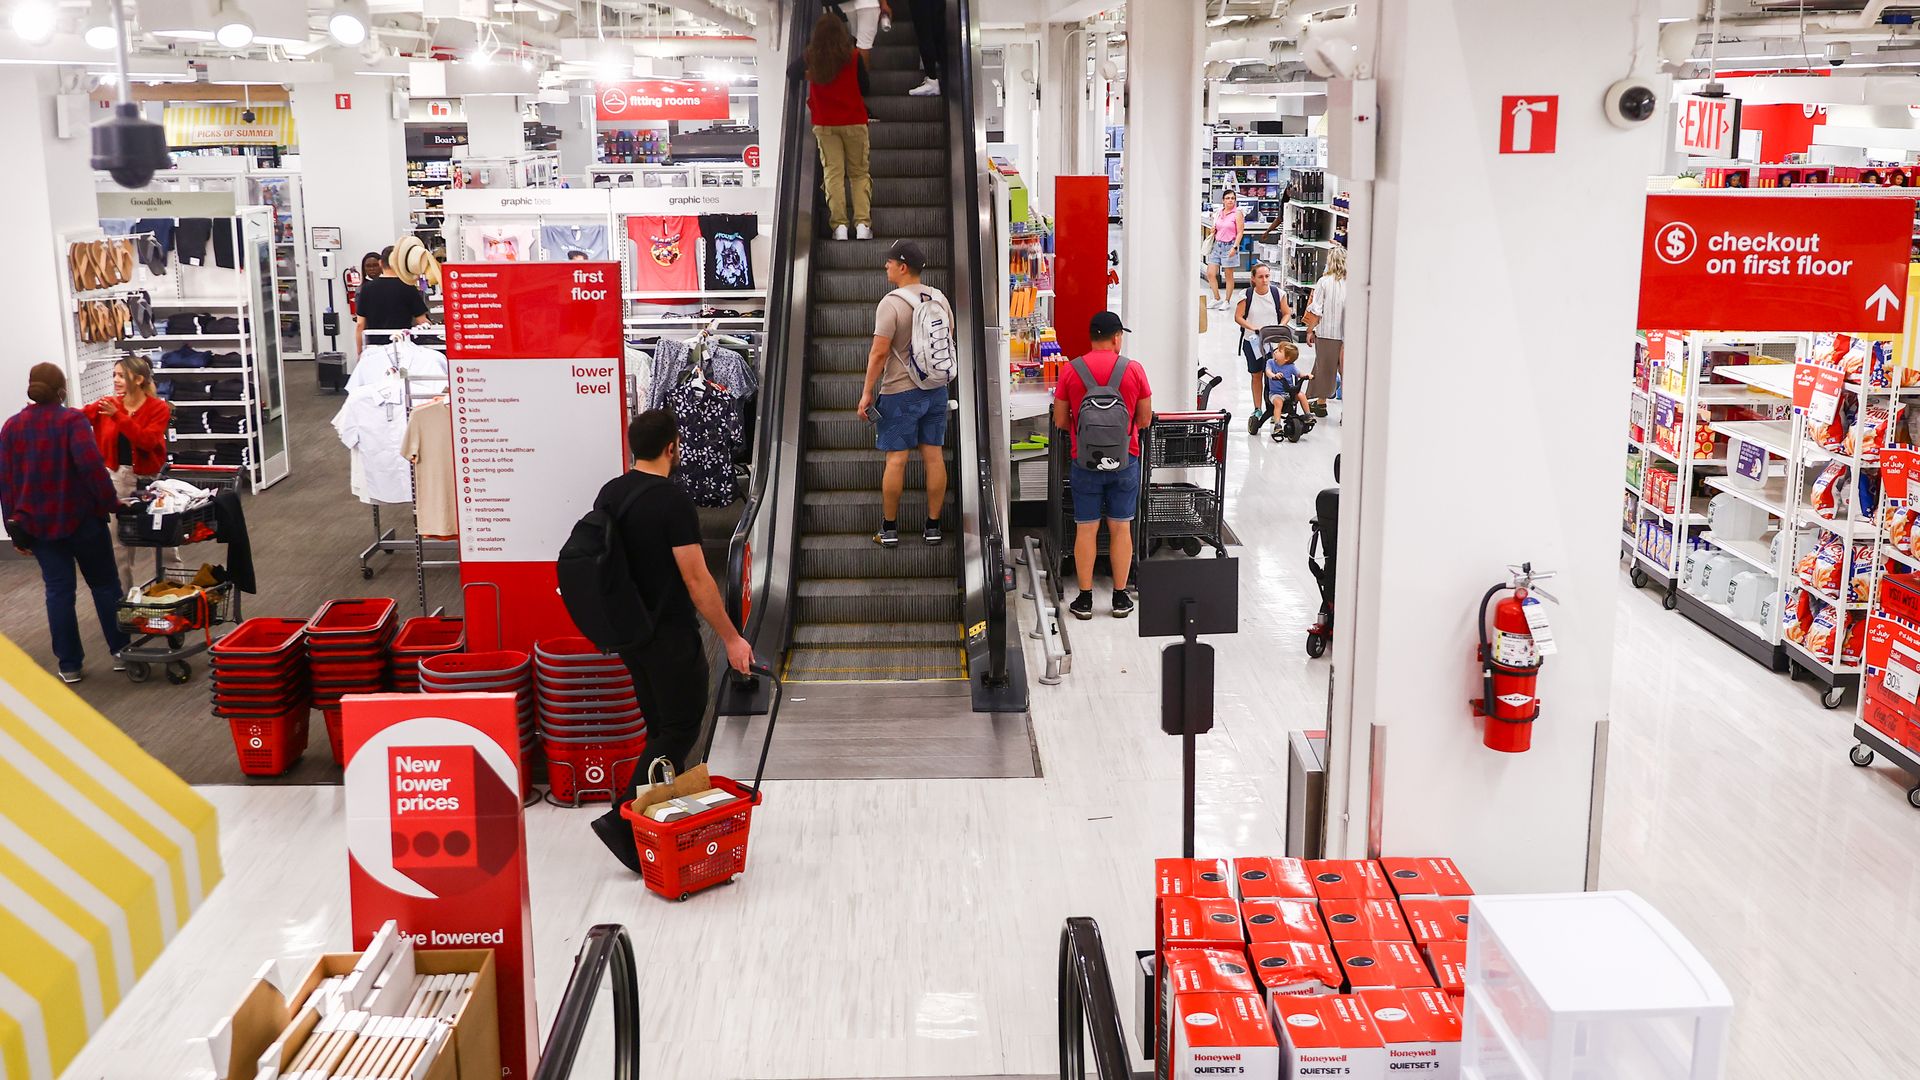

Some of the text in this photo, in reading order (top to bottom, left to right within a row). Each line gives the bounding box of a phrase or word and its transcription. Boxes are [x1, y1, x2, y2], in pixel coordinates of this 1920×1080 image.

[630, 96, 701, 108] fitting rooms
[1684, 101, 1726, 150] EXIT
[197, 129, 274, 138] PICKS OF SUMMER
[130, 197, 172, 206] Goodfellow
[501, 197, 533, 207] graphic
[668, 196, 720, 206] graphic tees
[1708, 231, 1820, 252] checkout
[1706, 255, 1853, 276] on first floor
[572, 270, 604, 283] first
[478, 292, 498, 300] pickup
[571, 286, 607, 300] floor
[462, 302, 479, 310] guest
[572, 365, 614, 378] lower
[576, 382, 610, 394] level
[1890, 462, 1904, 470] July
[1876, 630, 1890, 638] July
[1872, 636, 1885, 644] sale
[395, 756, 441, 773] New
[396, 775, 452, 792] lower
[397, 794, 460, 815] prices
[432, 929, 504, 945] lowered
[1194, 1054, 1241, 1062] Honeywell
[1390, 1049, 1436, 1058] Honeywell
[1300, 1054, 1347, 1064] Honeywell
[1194, 1066, 1244, 1074] QUIETSET 5
[1390, 1062, 1431, 1070] QUIETSET
